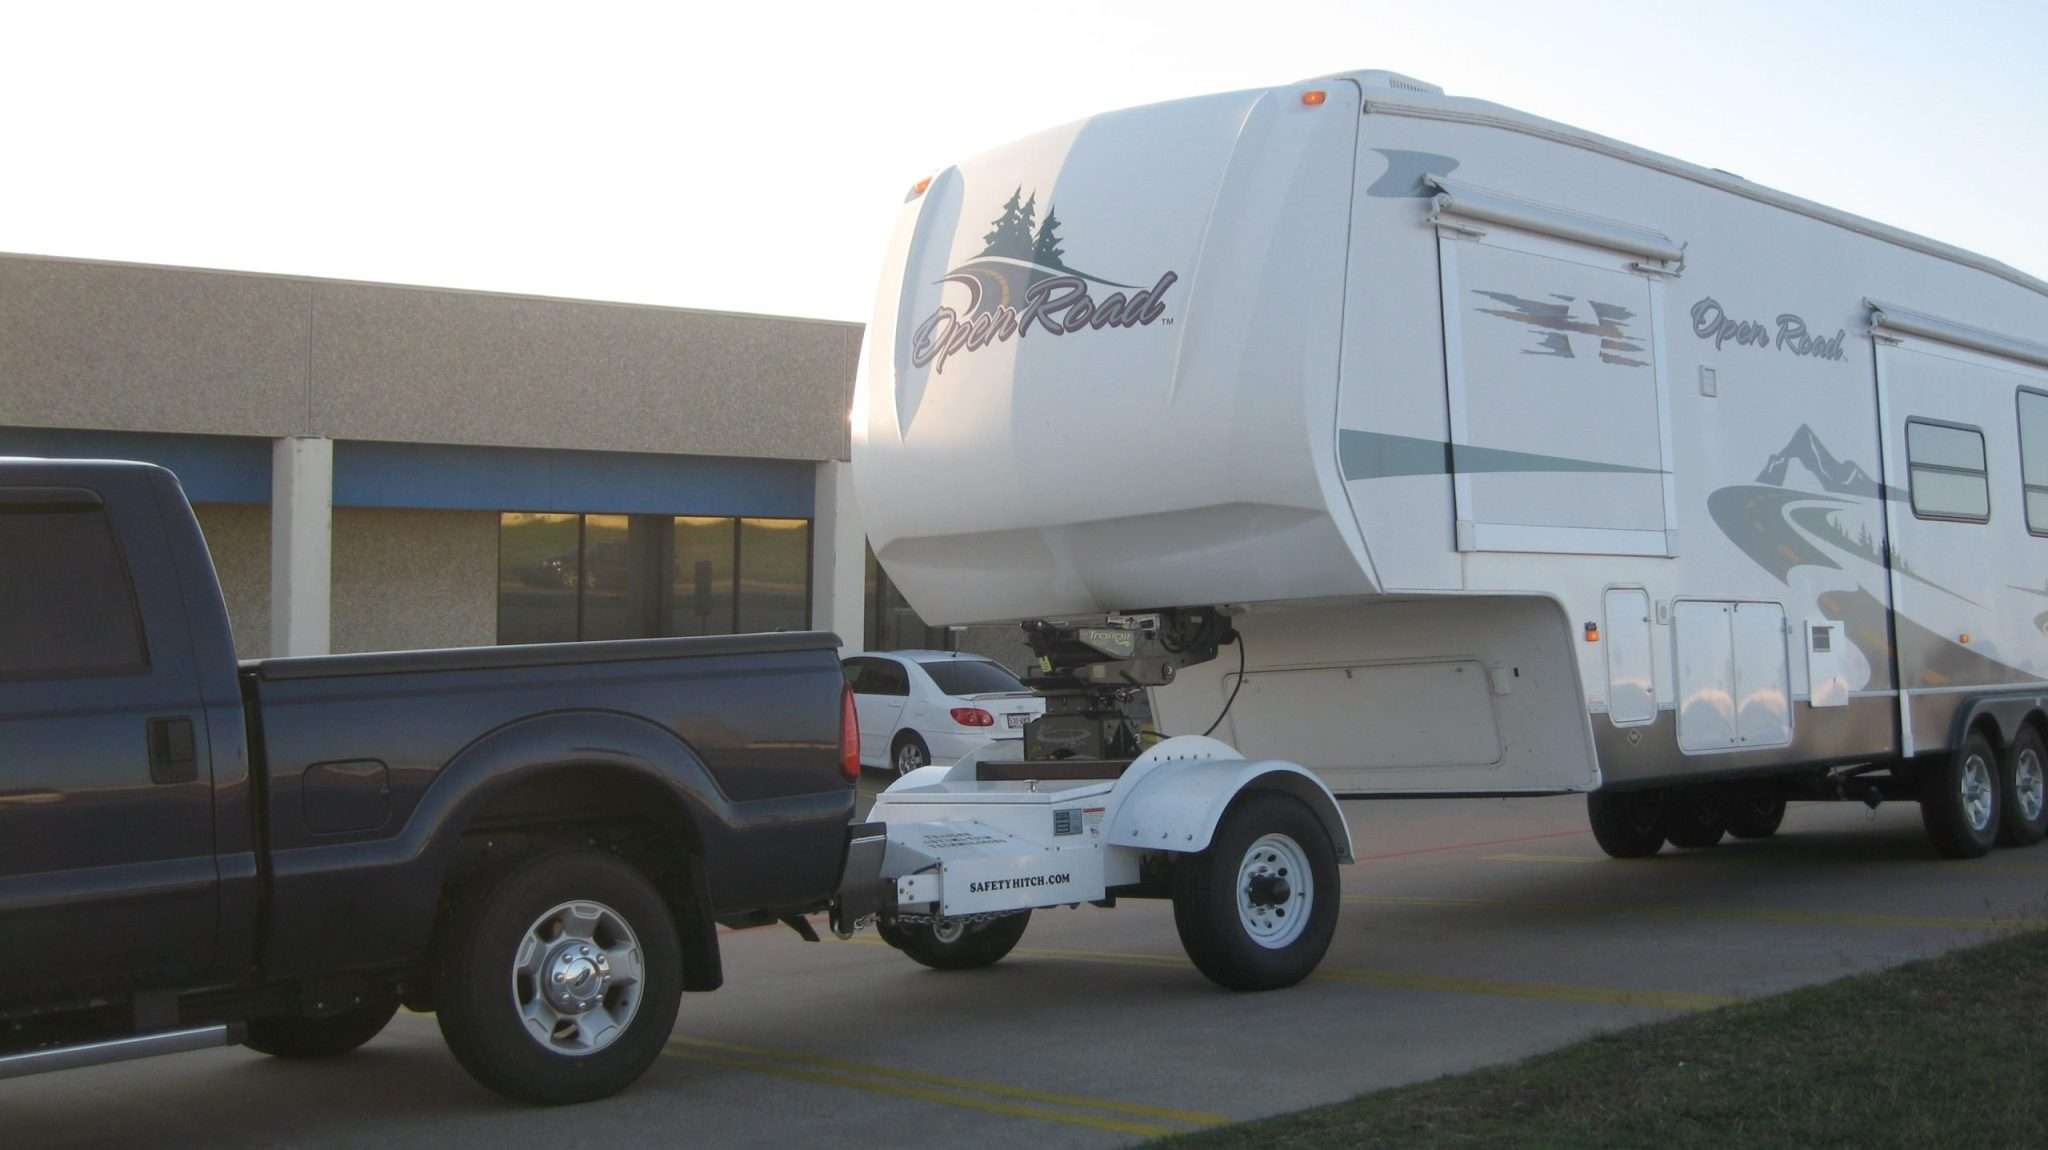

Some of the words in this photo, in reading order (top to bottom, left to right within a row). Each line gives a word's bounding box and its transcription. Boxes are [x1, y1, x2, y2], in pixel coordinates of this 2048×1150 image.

[1018, 270, 1178, 338] Road
[1690, 296, 1770, 351] Open
[1776, 313, 1846, 361] Road
[969, 873, 1071, 893] SAFETYHITCH.COM
